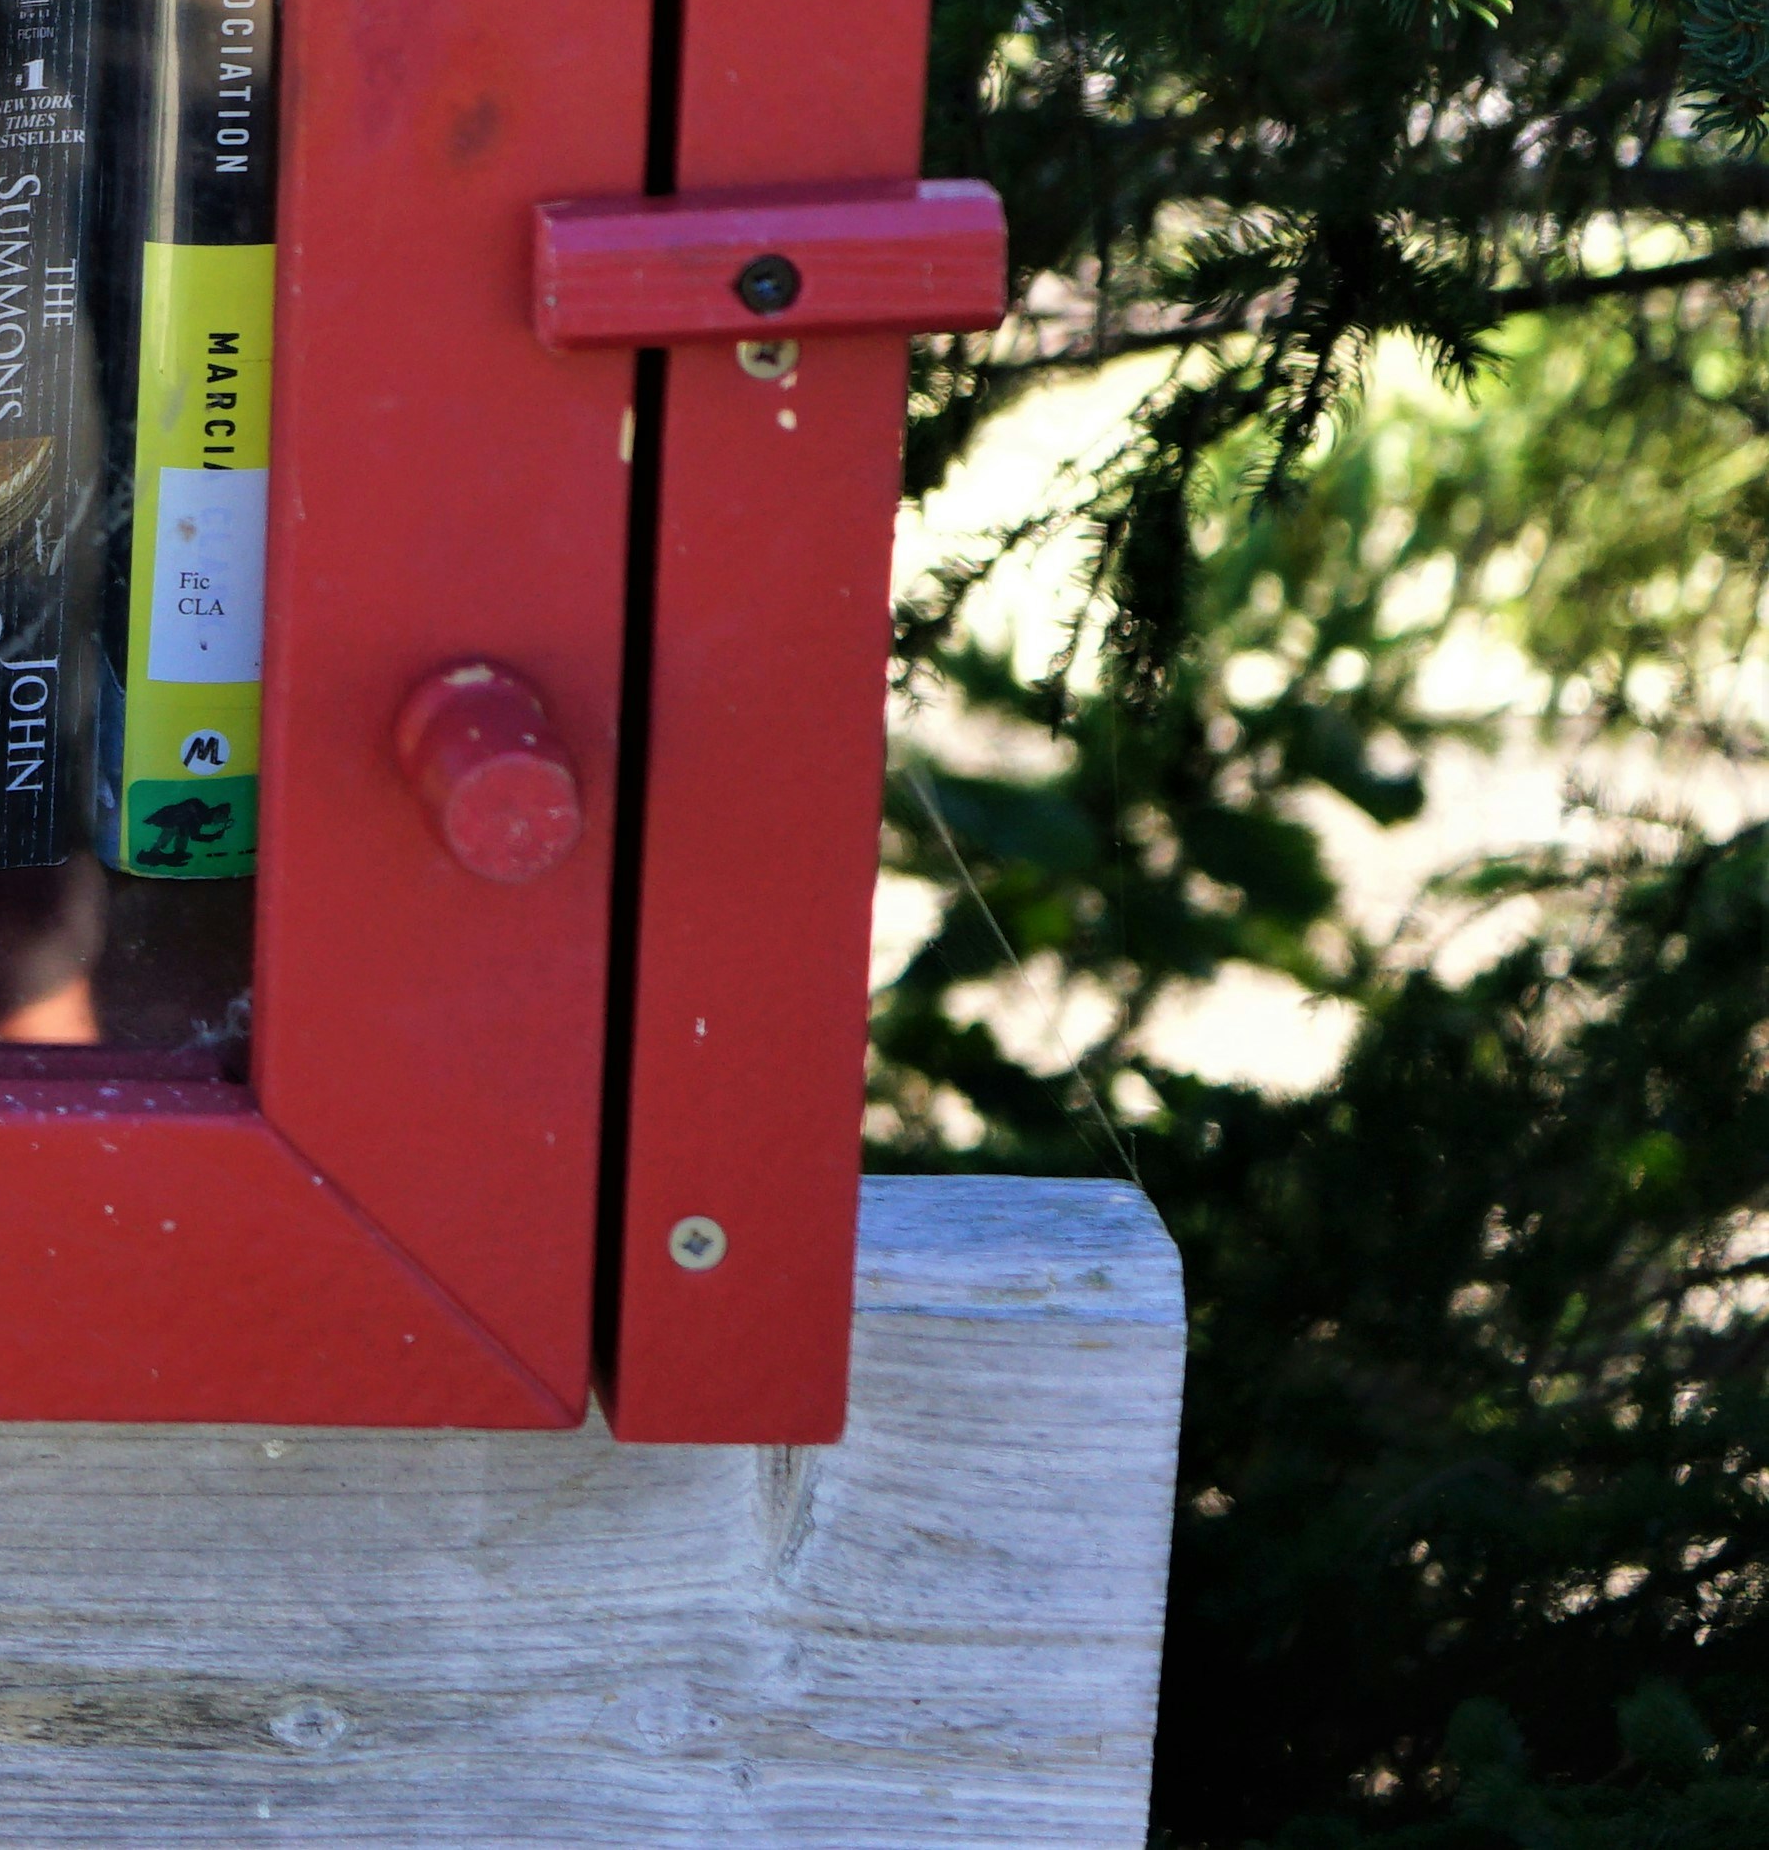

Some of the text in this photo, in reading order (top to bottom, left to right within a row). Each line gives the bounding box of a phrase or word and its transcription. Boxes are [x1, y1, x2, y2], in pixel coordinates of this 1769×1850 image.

[30, 95, 75, 111] YORK
[6, 113, 56, 128] TIMES
[43, 257, 76, 327] THE
[179, 572, 210, 590] Fic
[178, 599, 225, 616] CLA
[1, 654, 59, 794] JOHN
